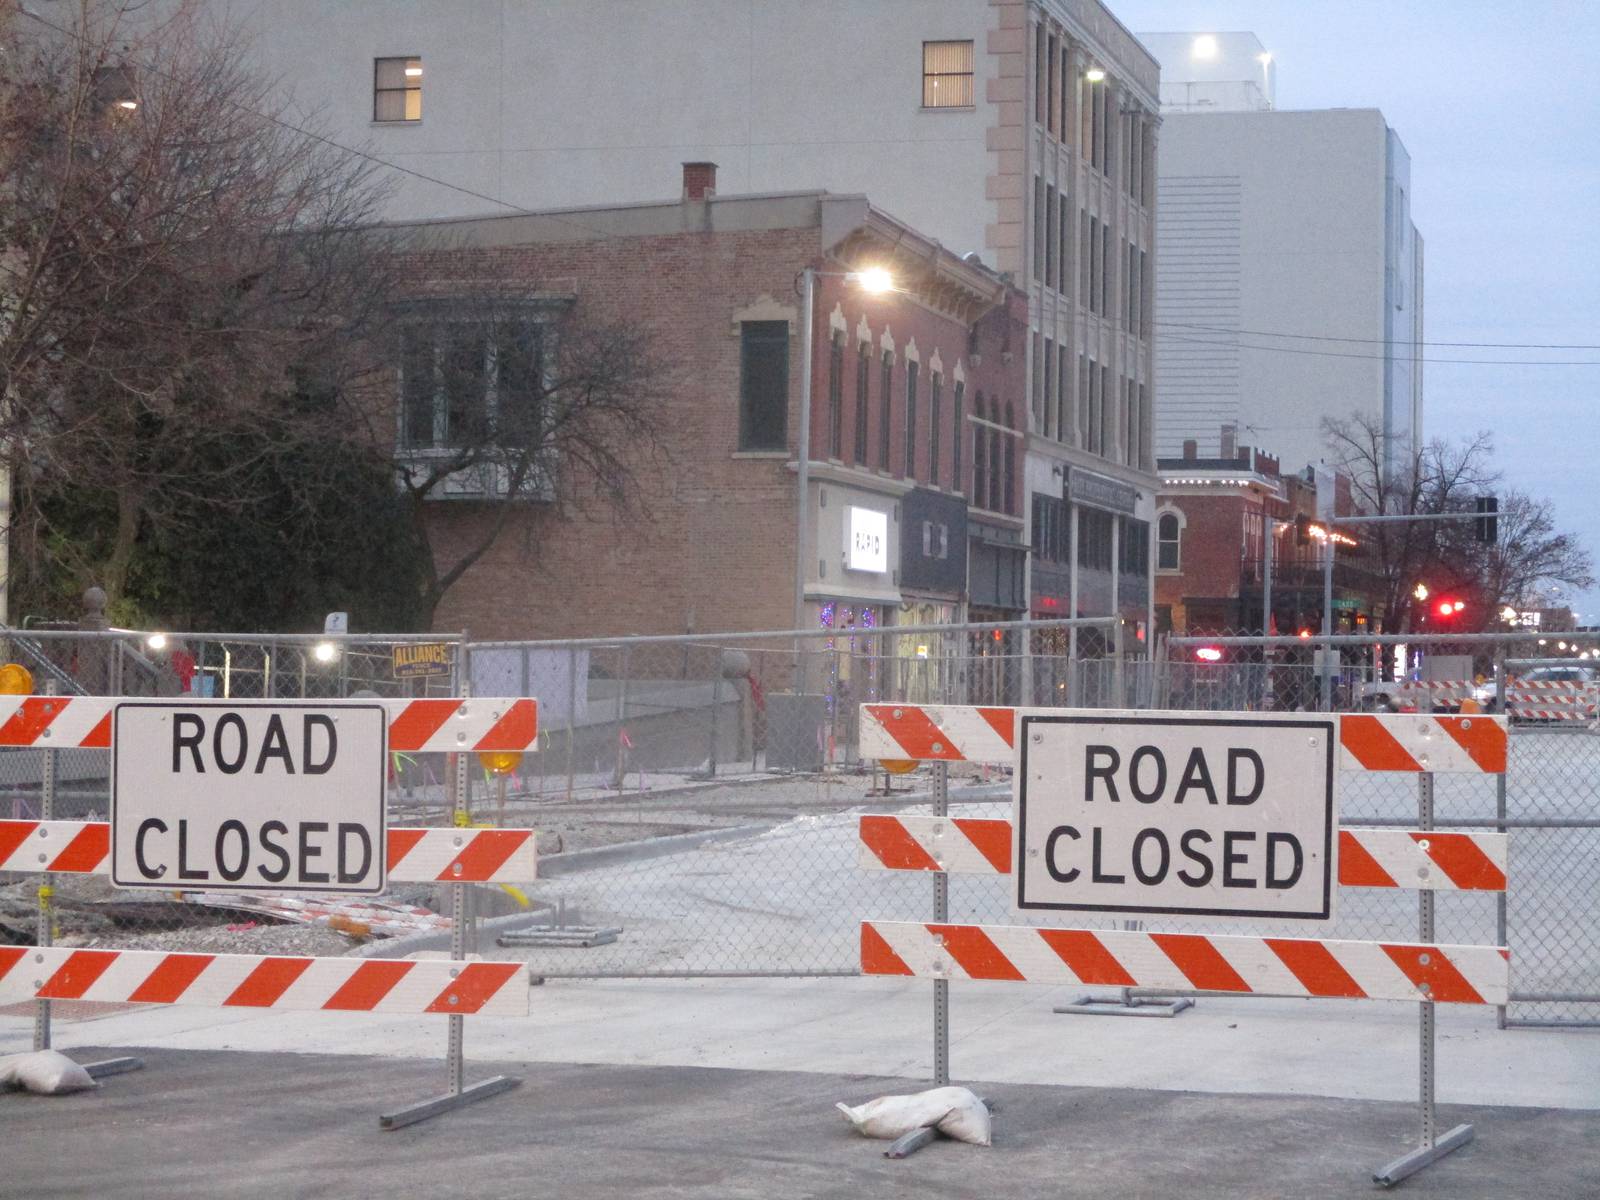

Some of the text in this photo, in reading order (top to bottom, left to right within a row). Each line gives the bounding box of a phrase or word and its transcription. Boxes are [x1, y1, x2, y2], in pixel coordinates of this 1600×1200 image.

[395, 644, 447, 667] ALLIANCE
[172, 712, 338, 775] ROAD
[1084, 745, 1265, 806] ROAD
[135, 817, 372, 883] CLOSED
[1045, 825, 1304, 890] CLOSED
